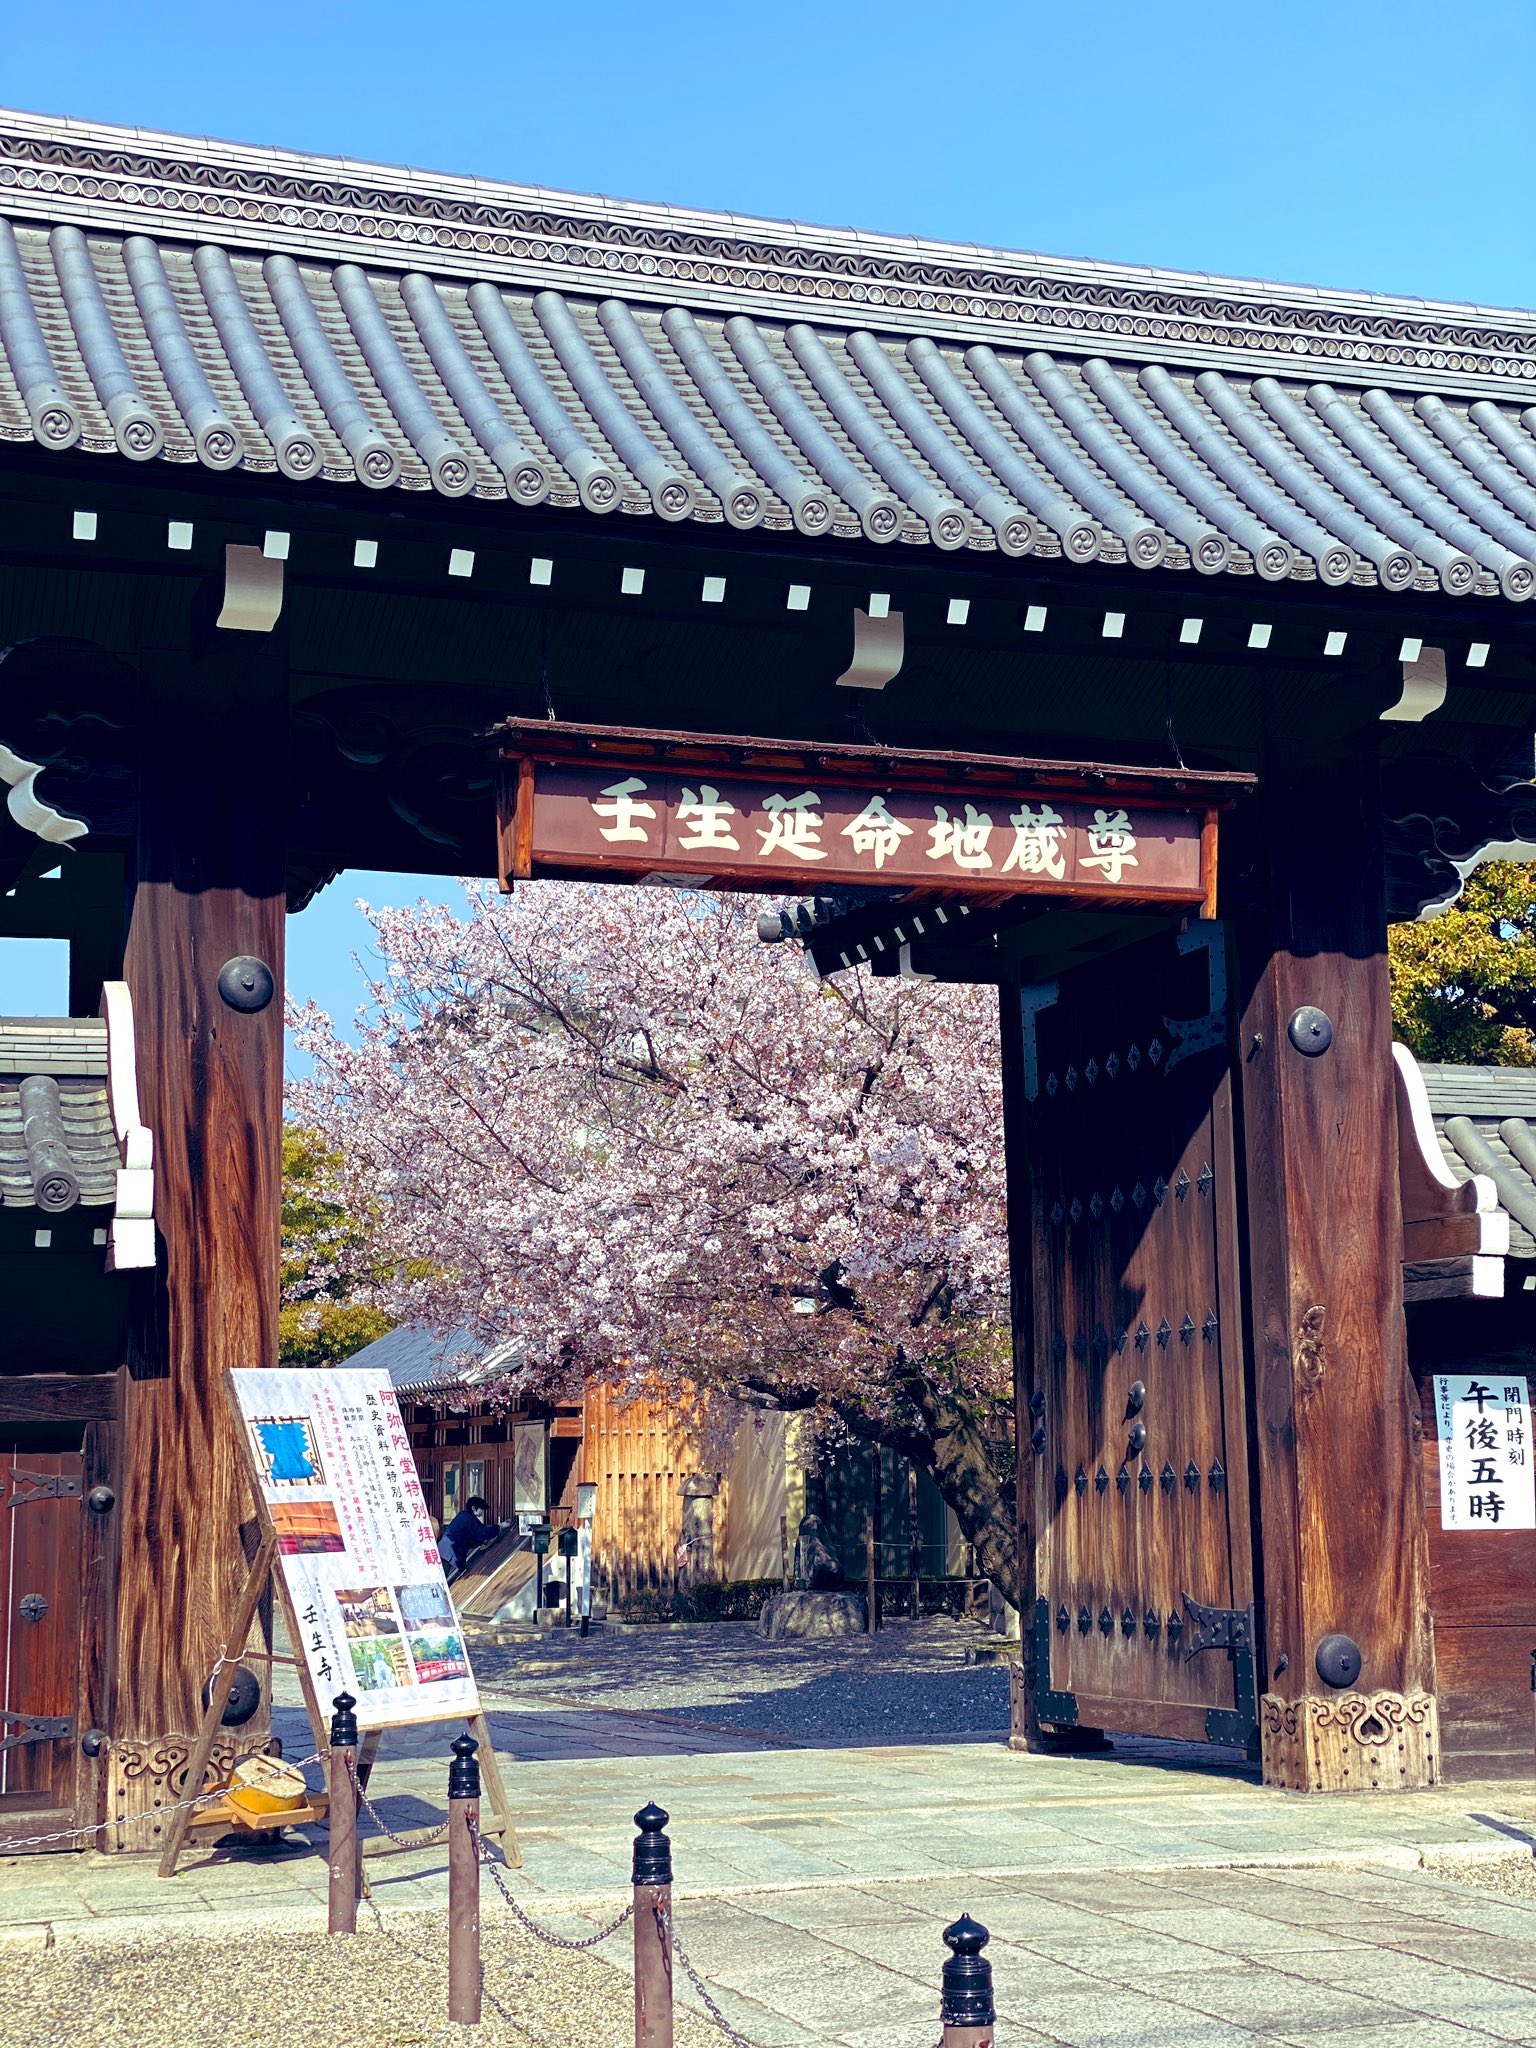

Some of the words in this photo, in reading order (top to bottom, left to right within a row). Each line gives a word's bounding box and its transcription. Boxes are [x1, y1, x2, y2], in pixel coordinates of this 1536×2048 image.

[591, 777, 1140, 883] 壬生延命地蔵尊
[366, 1394, 410, 1528] 歴史資料室特別展示
[379, 1390, 442, 1565] 阿弥陀堂特別拝観
[1461, 1381, 1506, 1523] 午後五時
[1503, 1386, 1525, 1466] 閉門時刻
[302, 1604, 332, 1681] 壬生寺
